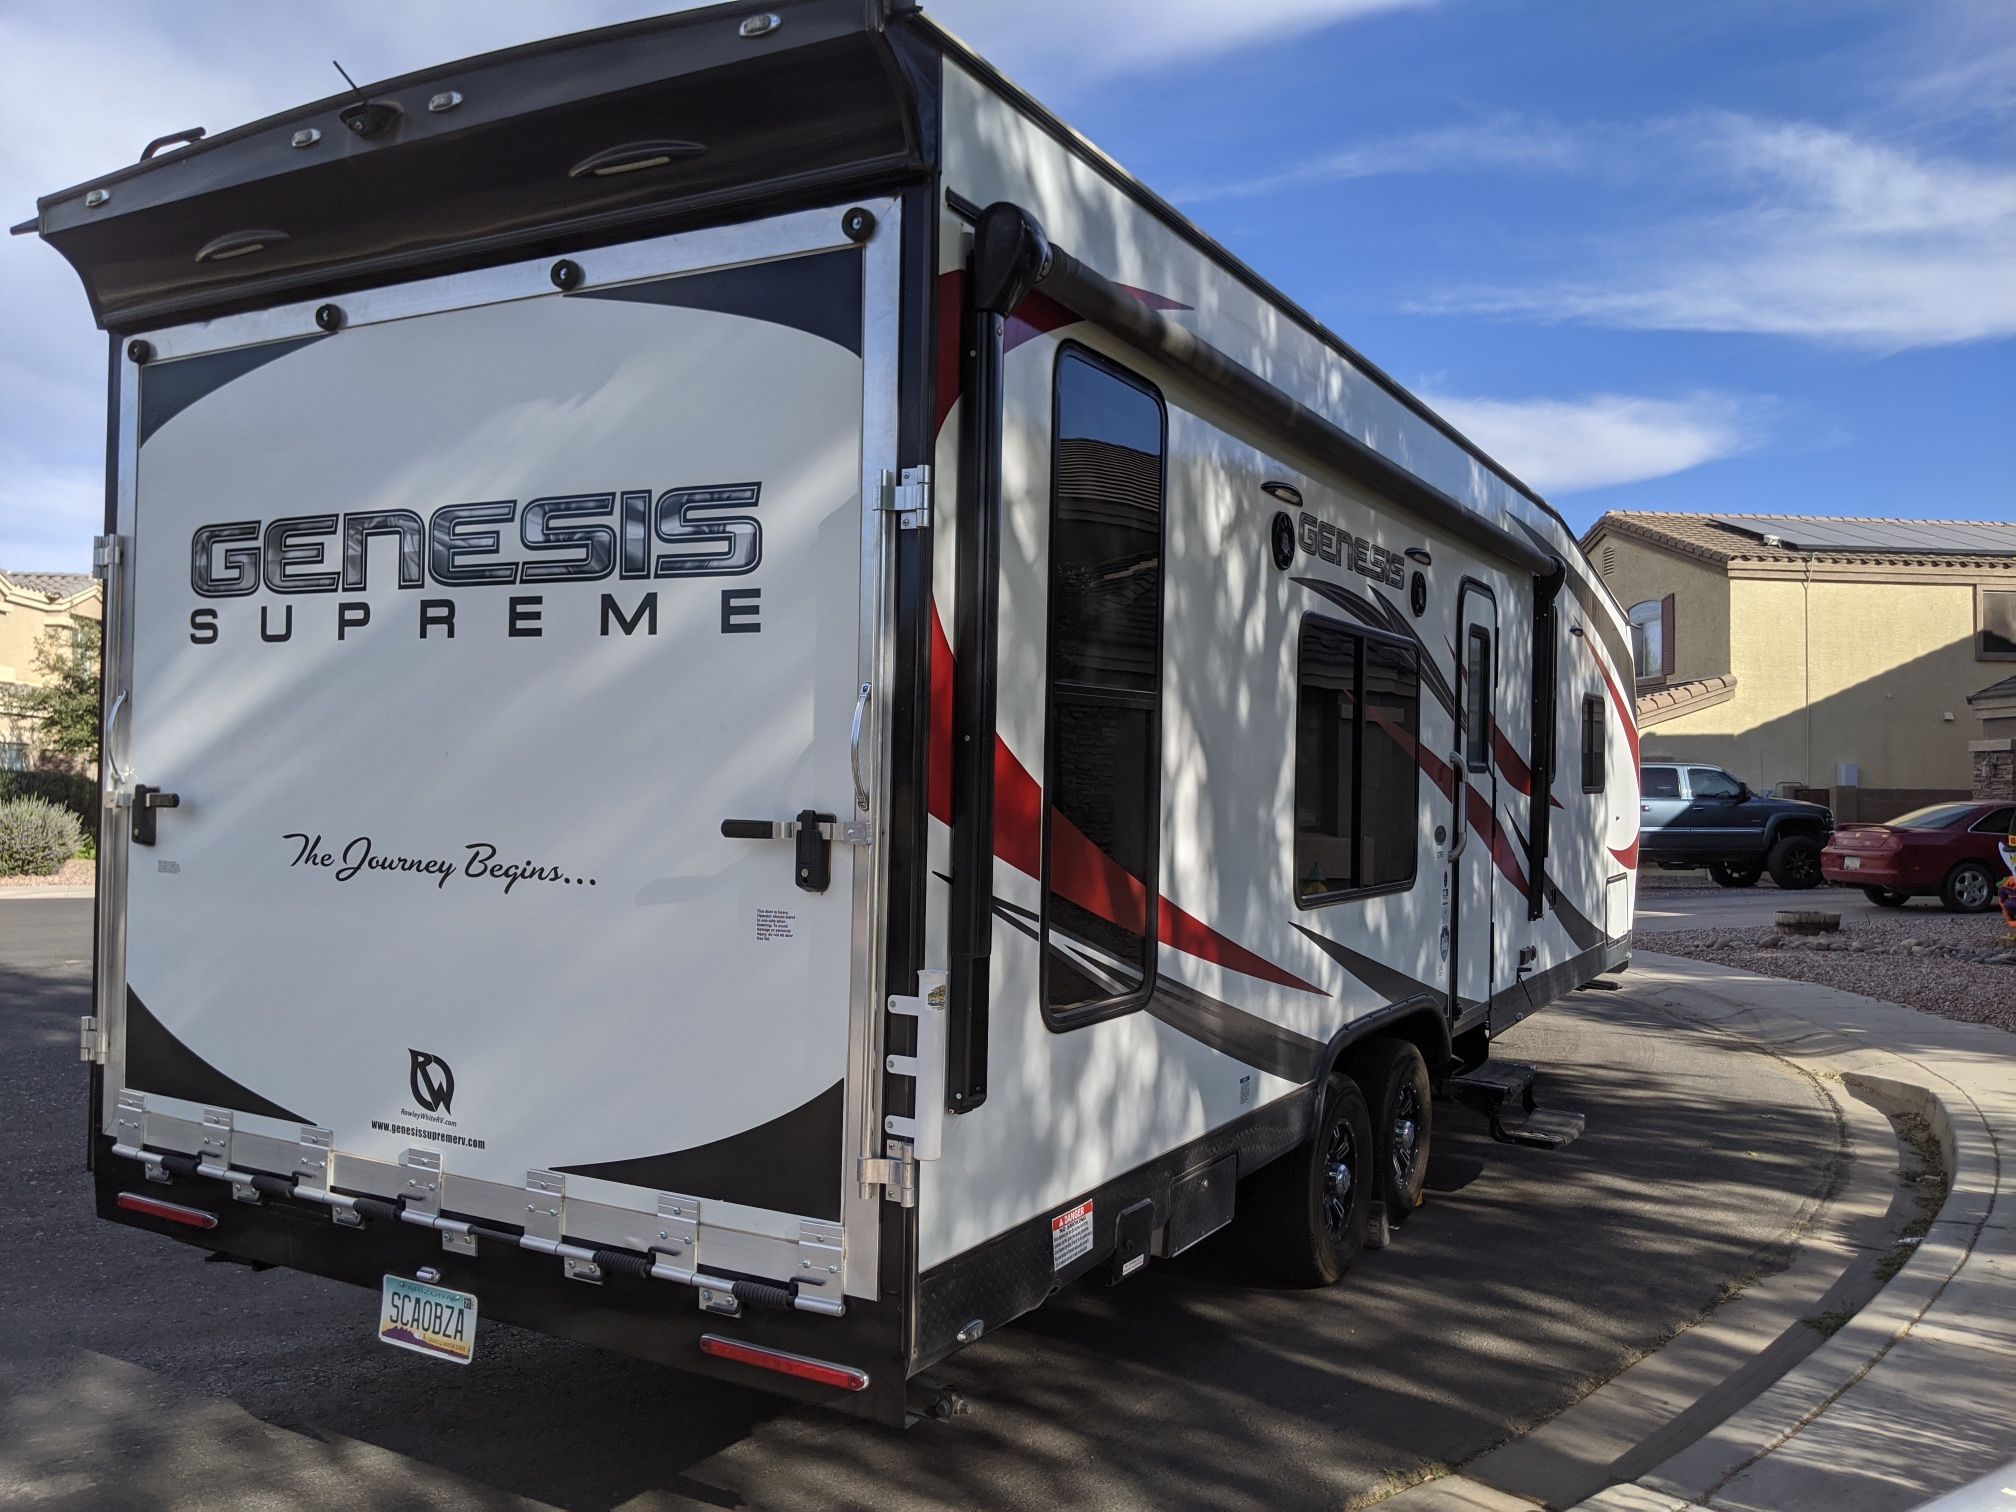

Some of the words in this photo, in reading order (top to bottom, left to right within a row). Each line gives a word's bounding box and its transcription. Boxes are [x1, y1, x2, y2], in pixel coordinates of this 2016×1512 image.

[190, 588, 762, 644] SUPREME
[282, 833, 335, 867] The
[335, 836, 456, 889] Journey
[371, 1120, 486, 1150] www.genesissupremerv.com
